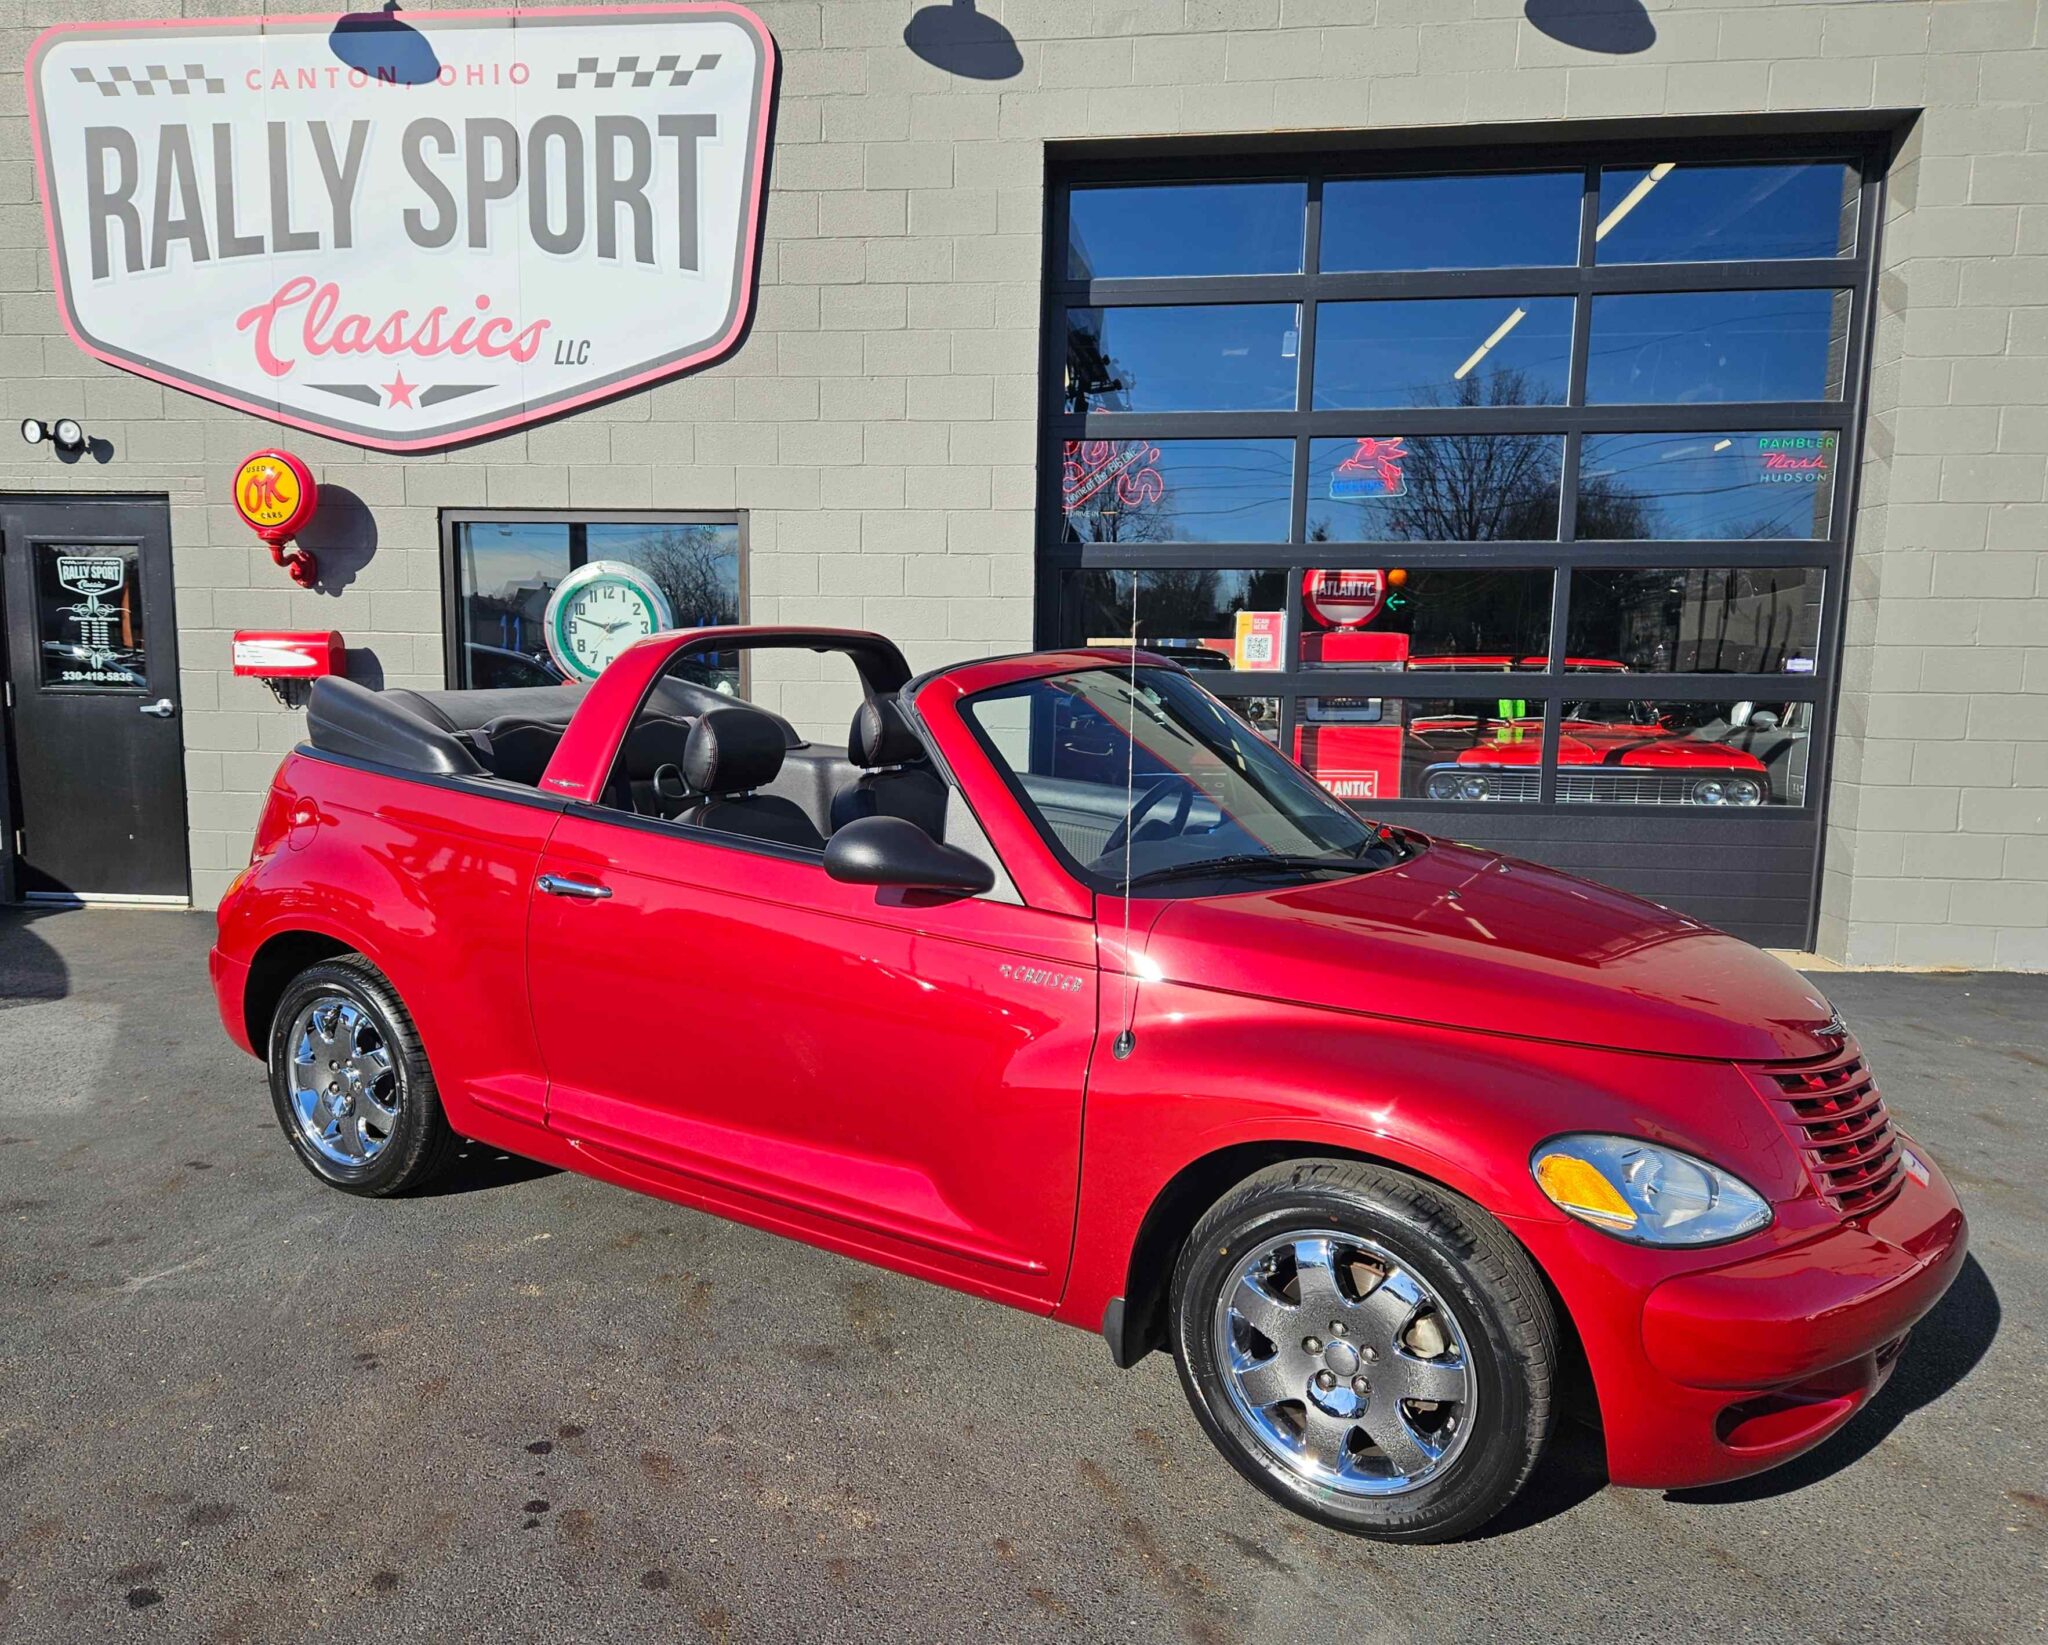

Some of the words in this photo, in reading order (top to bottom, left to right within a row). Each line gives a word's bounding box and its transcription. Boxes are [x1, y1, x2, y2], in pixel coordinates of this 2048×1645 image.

[245, 65, 412, 91] CANTON,
[436, 62, 530, 88] OHIO
[84, 119, 371, 280] RALLY
[401, 113, 717, 272] SPORT
[236, 276, 552, 377] Classics
[553, 339, 591, 366] LLC
[1759, 437, 1834, 449] RAMBLER
[1761, 452, 1829, 469] Nash
[246, 465, 267, 473] USED
[1759, 472, 1828, 483] HUDSON
[244, 466, 290, 513] OK
[261, 511, 283, 519] CARS
[62, 565, 90, 580] RALLY
[90, 565, 120, 581] SPORT
[603, 585, 615, 600] 12
[1318, 580, 1377, 597] ATLANTIC
[575, 602, 586, 616] 10
[632, 602, 641, 616] 2
[569, 621, 577, 634] 9
[640, 621, 649, 635] 3
[577, 639, 586, 653] 8
[590, 650, 599, 664] 7
[62, 671, 134, 682] 330-418-5836
[1014, 966, 1083, 992] CRUISER
